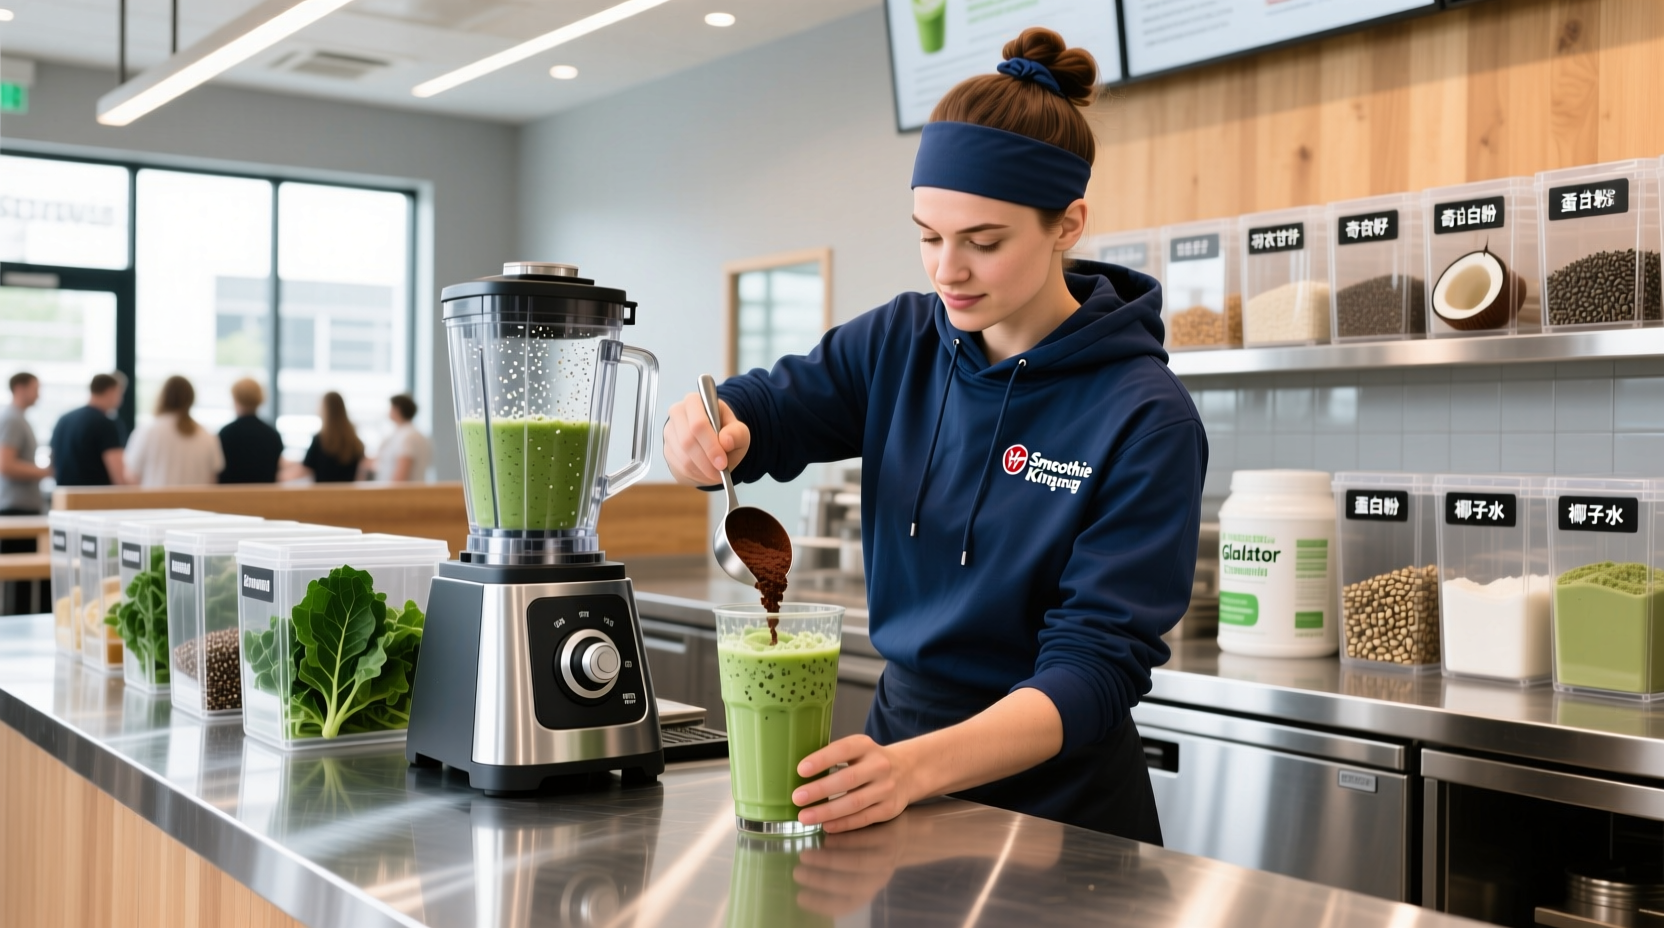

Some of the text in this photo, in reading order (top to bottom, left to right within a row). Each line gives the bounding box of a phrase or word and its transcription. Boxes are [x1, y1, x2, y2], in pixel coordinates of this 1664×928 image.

[1454, 499, 1505, 520] 椰子水
[1568, 502, 1624, 526] 椰子水
